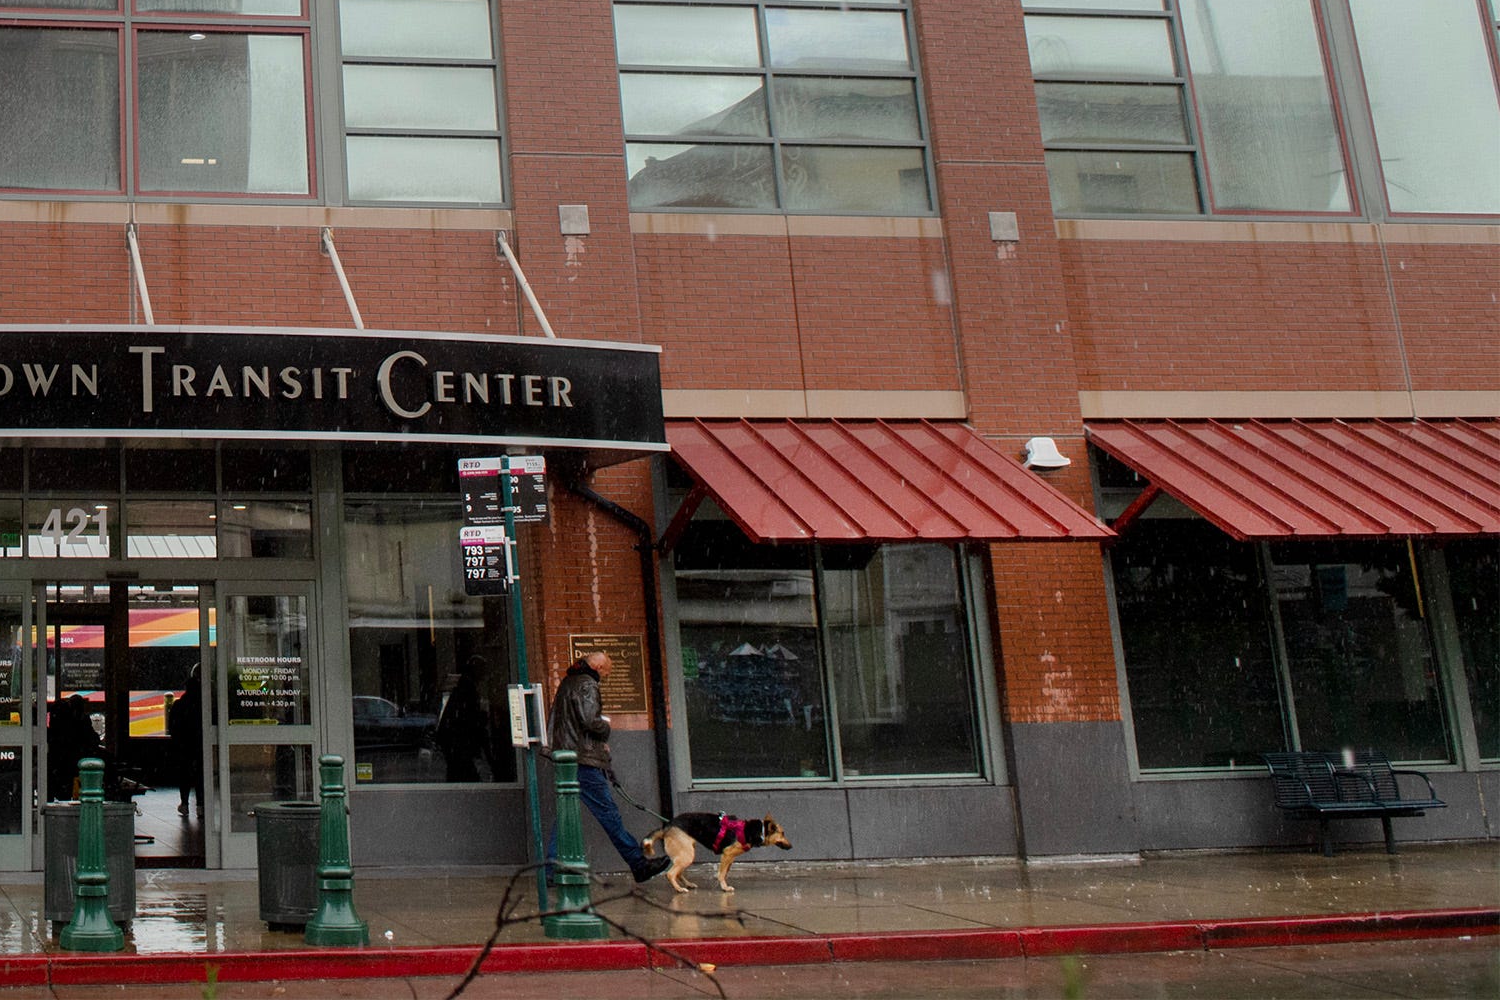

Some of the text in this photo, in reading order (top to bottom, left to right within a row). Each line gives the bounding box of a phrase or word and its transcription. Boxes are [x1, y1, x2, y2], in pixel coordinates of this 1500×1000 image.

[129, 345, 352, 413] TRANSIT
[378, 350, 574, 418] CENTER
[466, 505, 472, 513] 9
[41, 508, 108, 544] 421
[464, 546, 483, 556] 793
[465, 556, 485, 567] 797
[466, 568, 486, 579] 797
